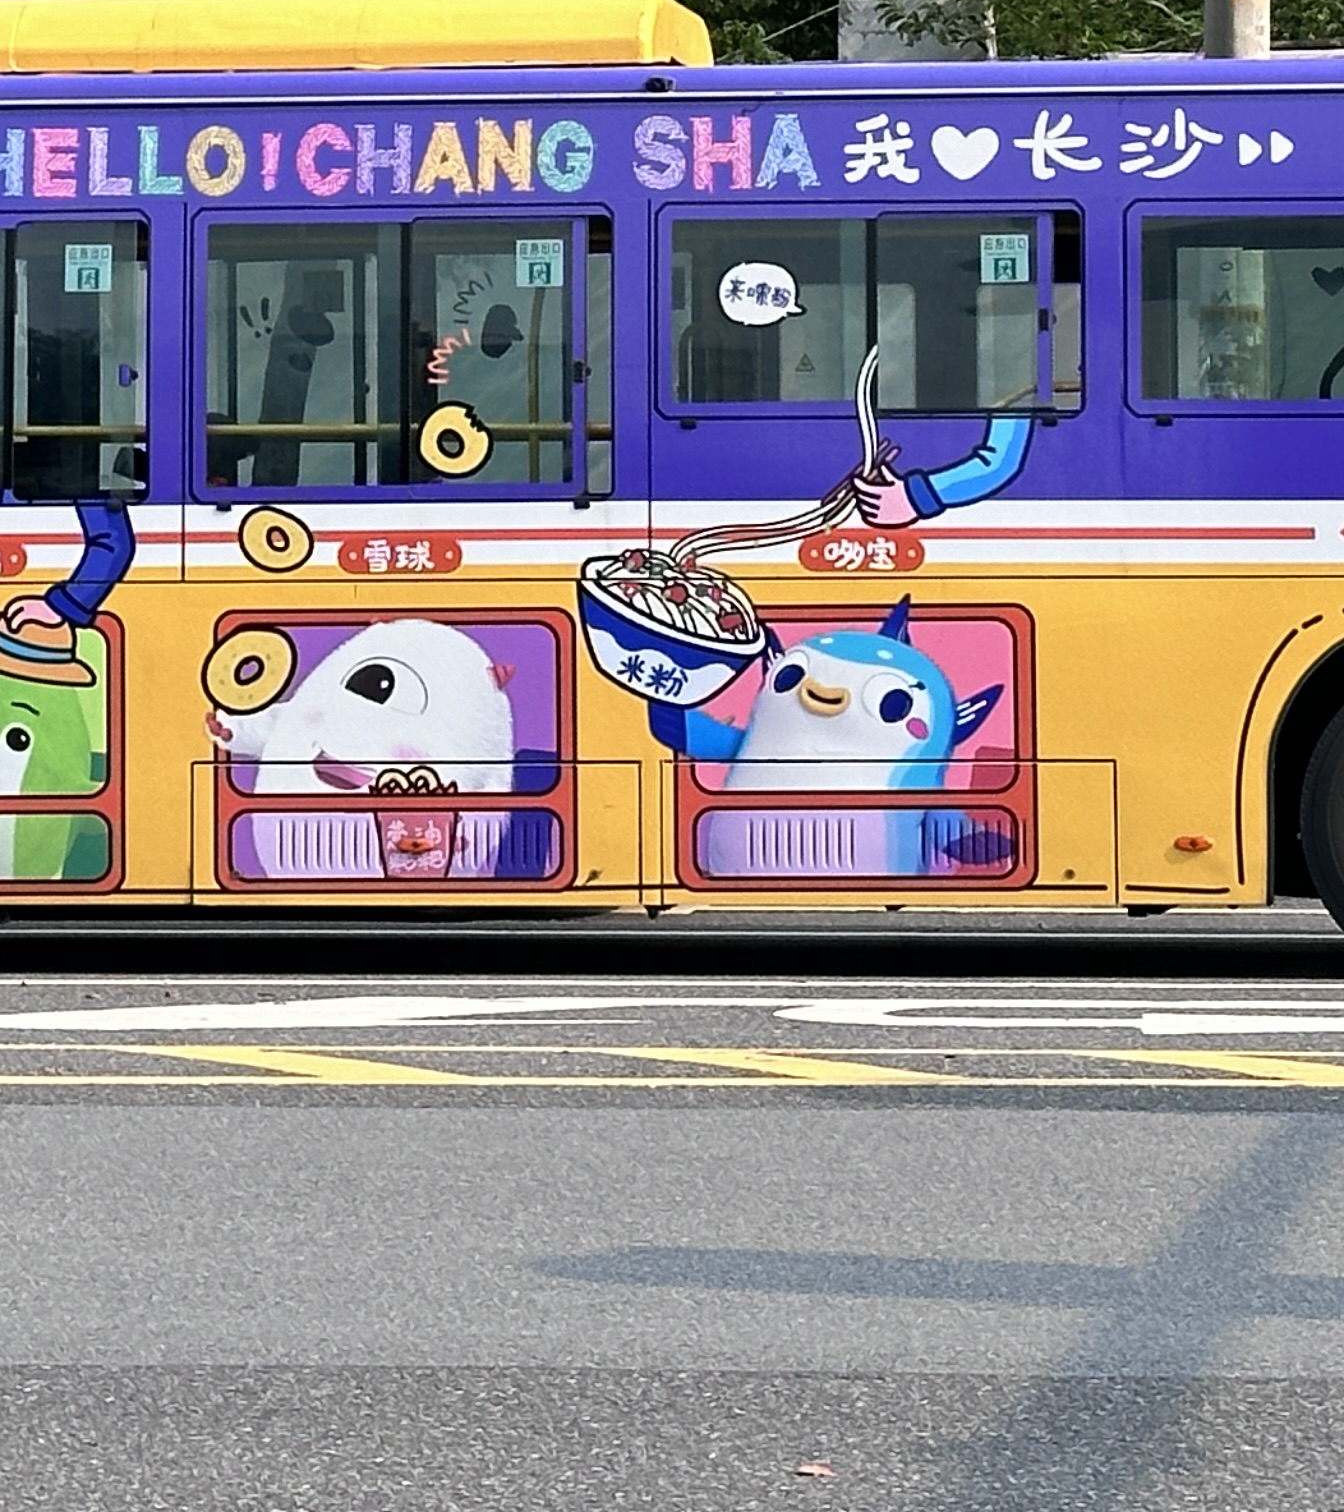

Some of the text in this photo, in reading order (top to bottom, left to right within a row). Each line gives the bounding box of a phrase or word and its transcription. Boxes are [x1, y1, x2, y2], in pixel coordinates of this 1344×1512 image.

[632, 111, 821, 193] SHA
[843, 108, 1224, 183] 我 长沙
[363, 539, 435, 572] 雪球
[823, 536, 897, 570] 哆宝
[616, 654, 689, 697] 米粉
